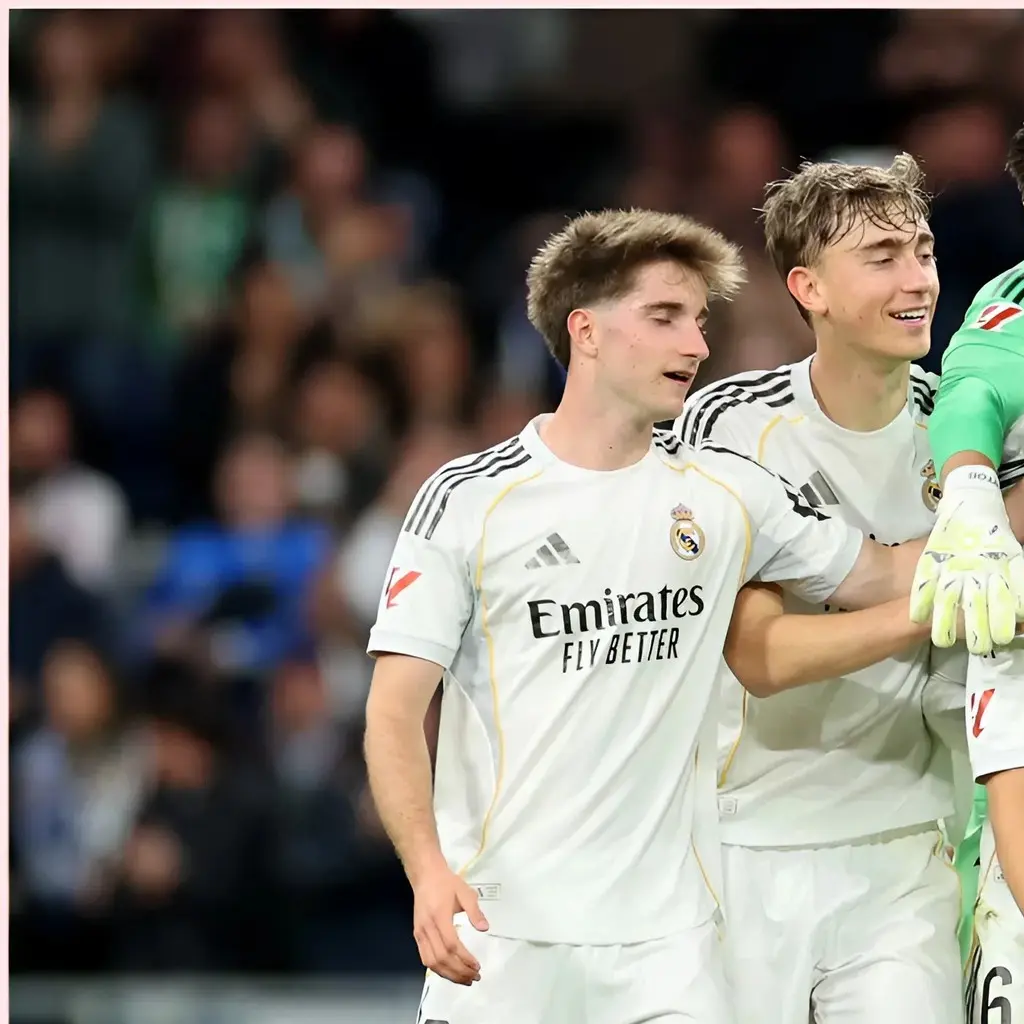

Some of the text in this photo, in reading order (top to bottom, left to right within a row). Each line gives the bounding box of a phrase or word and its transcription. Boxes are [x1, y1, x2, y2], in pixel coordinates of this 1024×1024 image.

[527, 583, 705, 639] Emirates
[562, 627, 680, 674] FLY BETTER
